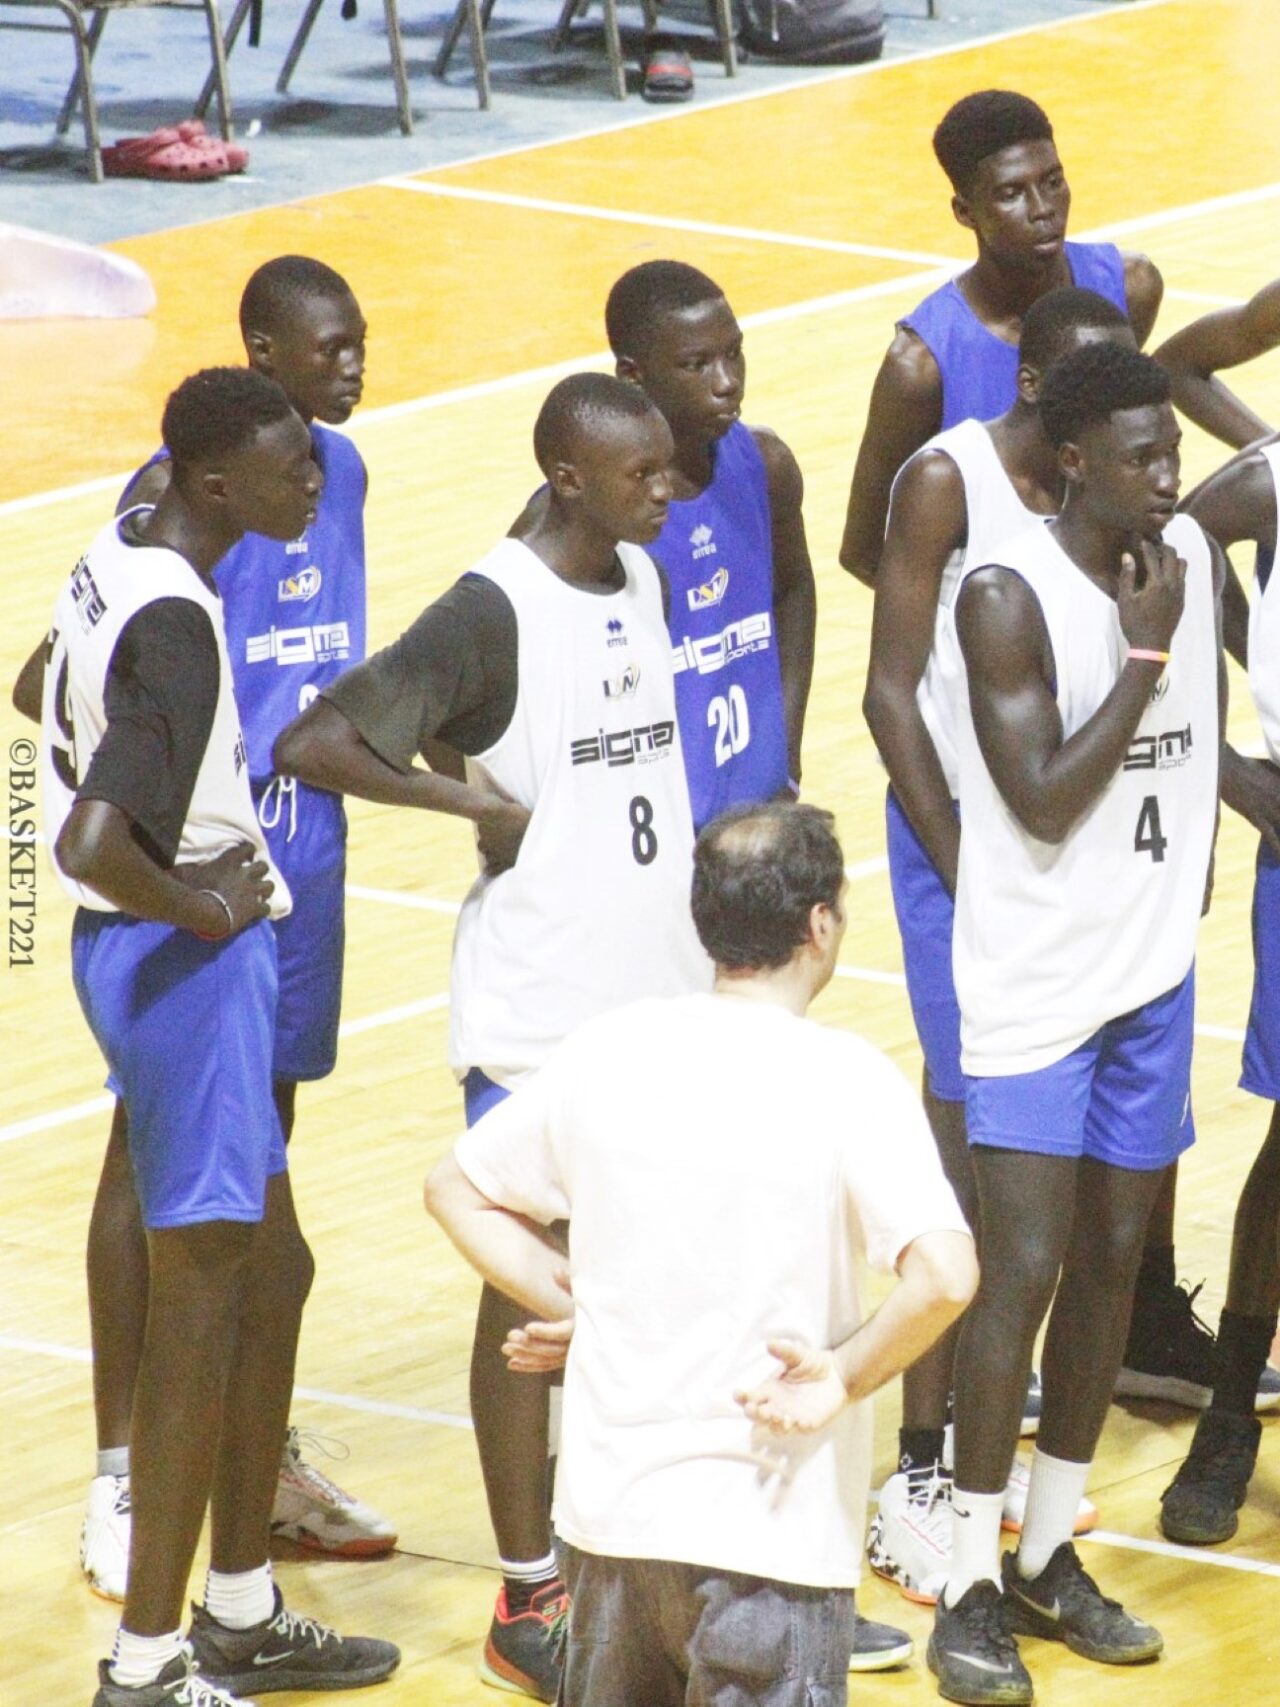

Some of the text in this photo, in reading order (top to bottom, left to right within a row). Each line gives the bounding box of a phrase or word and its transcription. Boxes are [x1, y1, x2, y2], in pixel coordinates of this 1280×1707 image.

[246, 621, 350, 666] sigma
[571, 720, 674, 768] sigma
[707, 684, 750, 768] 20
[629, 795, 658, 866] 8
[1134, 795, 1168, 863] 4
